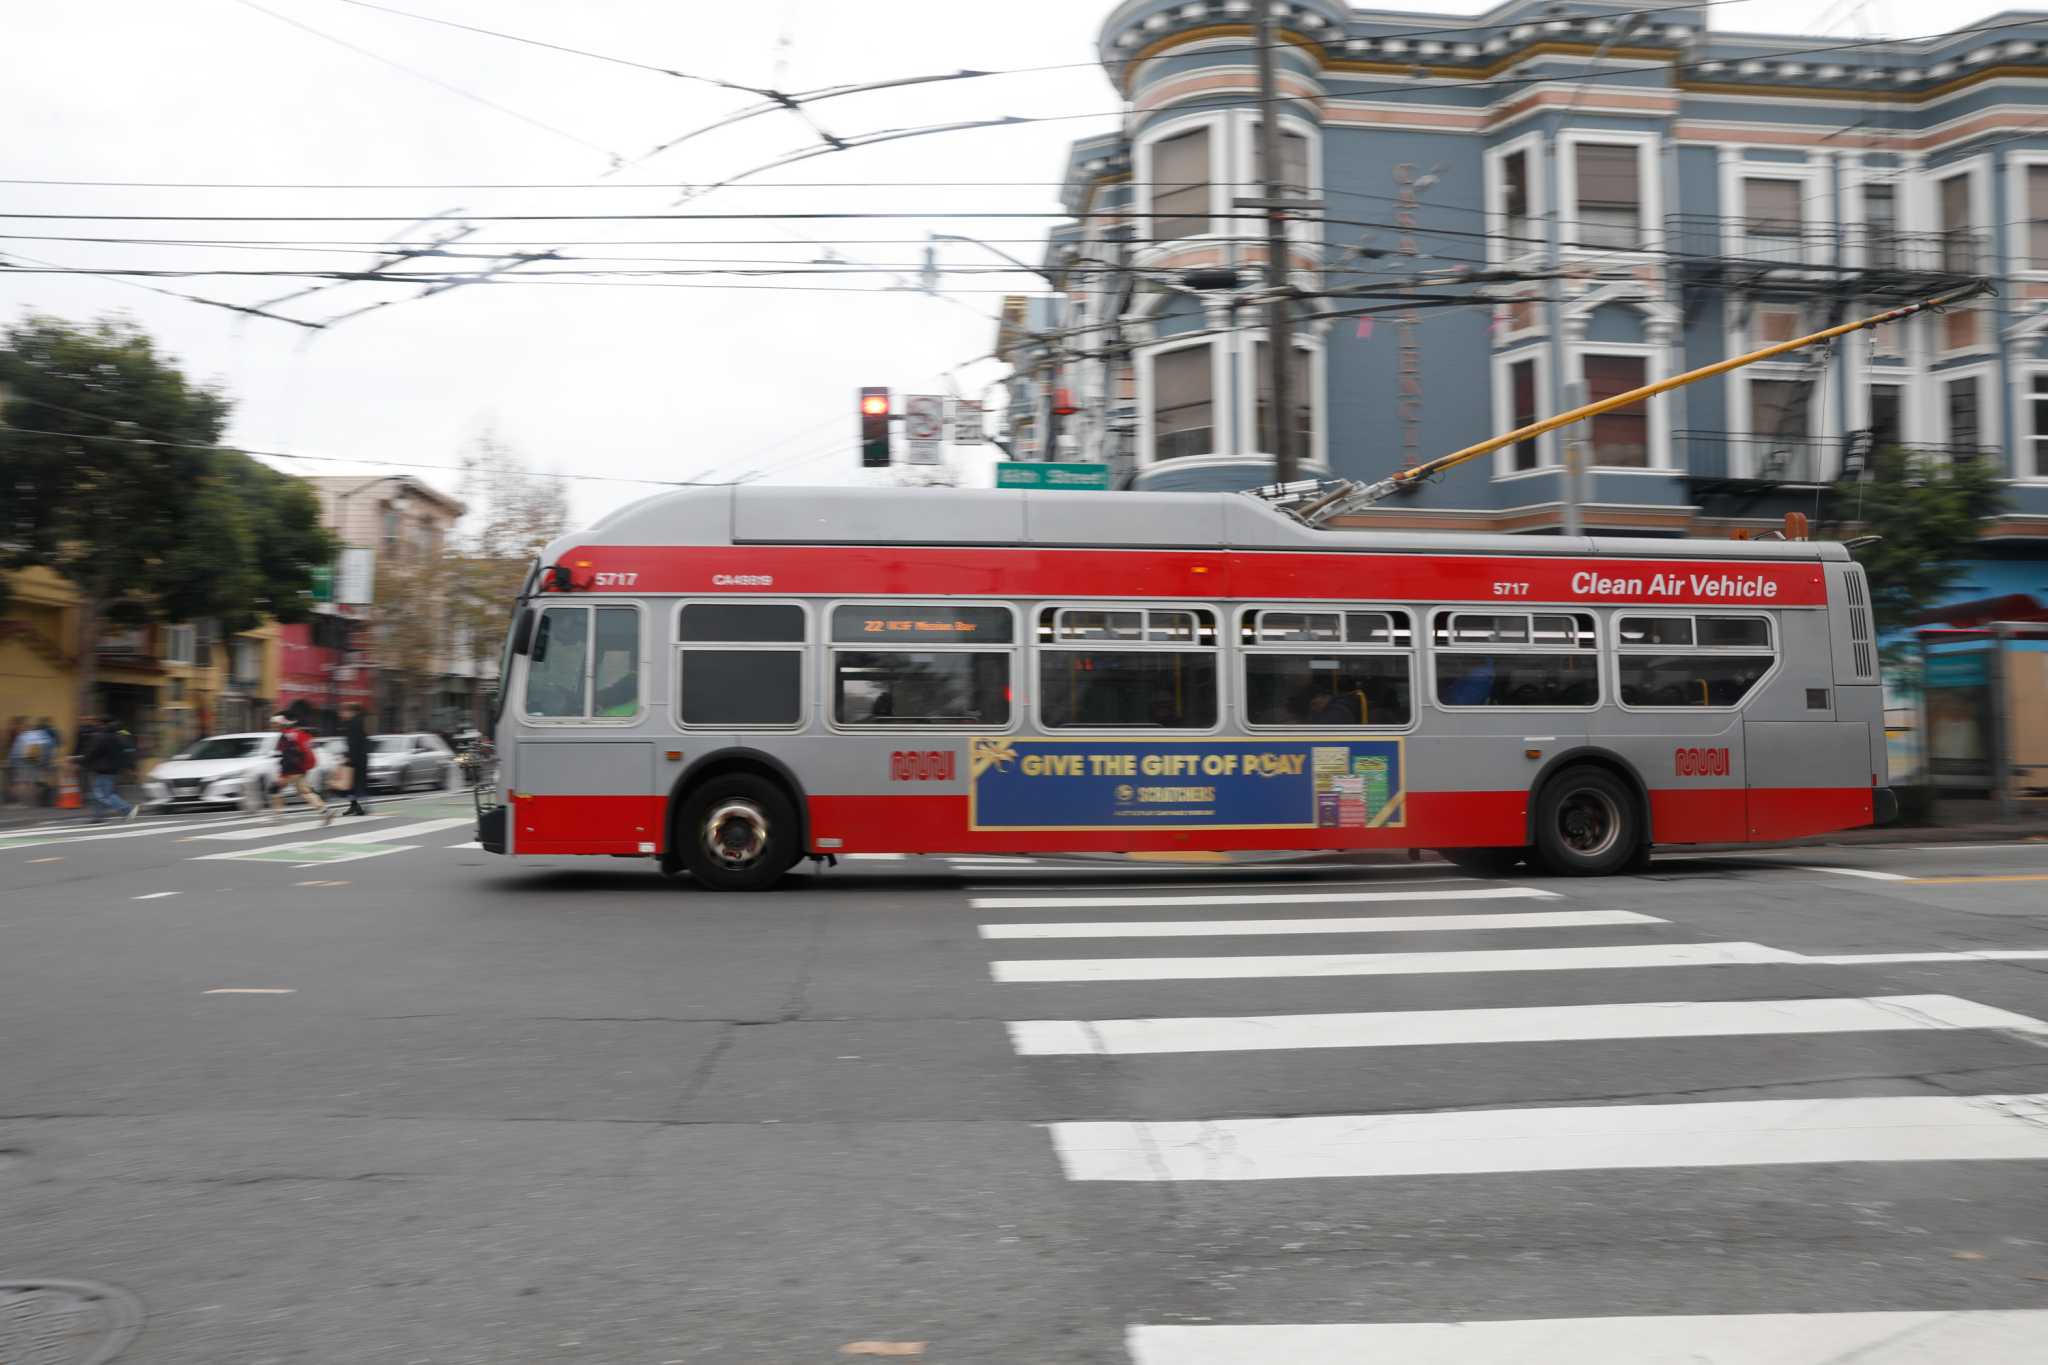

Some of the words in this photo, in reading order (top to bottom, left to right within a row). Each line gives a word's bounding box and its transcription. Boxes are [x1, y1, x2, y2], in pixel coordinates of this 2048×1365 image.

[595, 573, 638, 585] 5717
[1571, 571, 1642, 594] Clean
[1648, 573, 1685, 596] Air
[1690, 574, 1777, 597] Vehicle
[1493, 583, 1529, 595] 5717
[864, 620, 886, 632] 22
[1022, 754, 1084, 776] GIVE
[1088, 754, 1137, 776] THE
[1142, 754, 1200, 776] GIFT
[1202, 754, 1238, 776] OF
